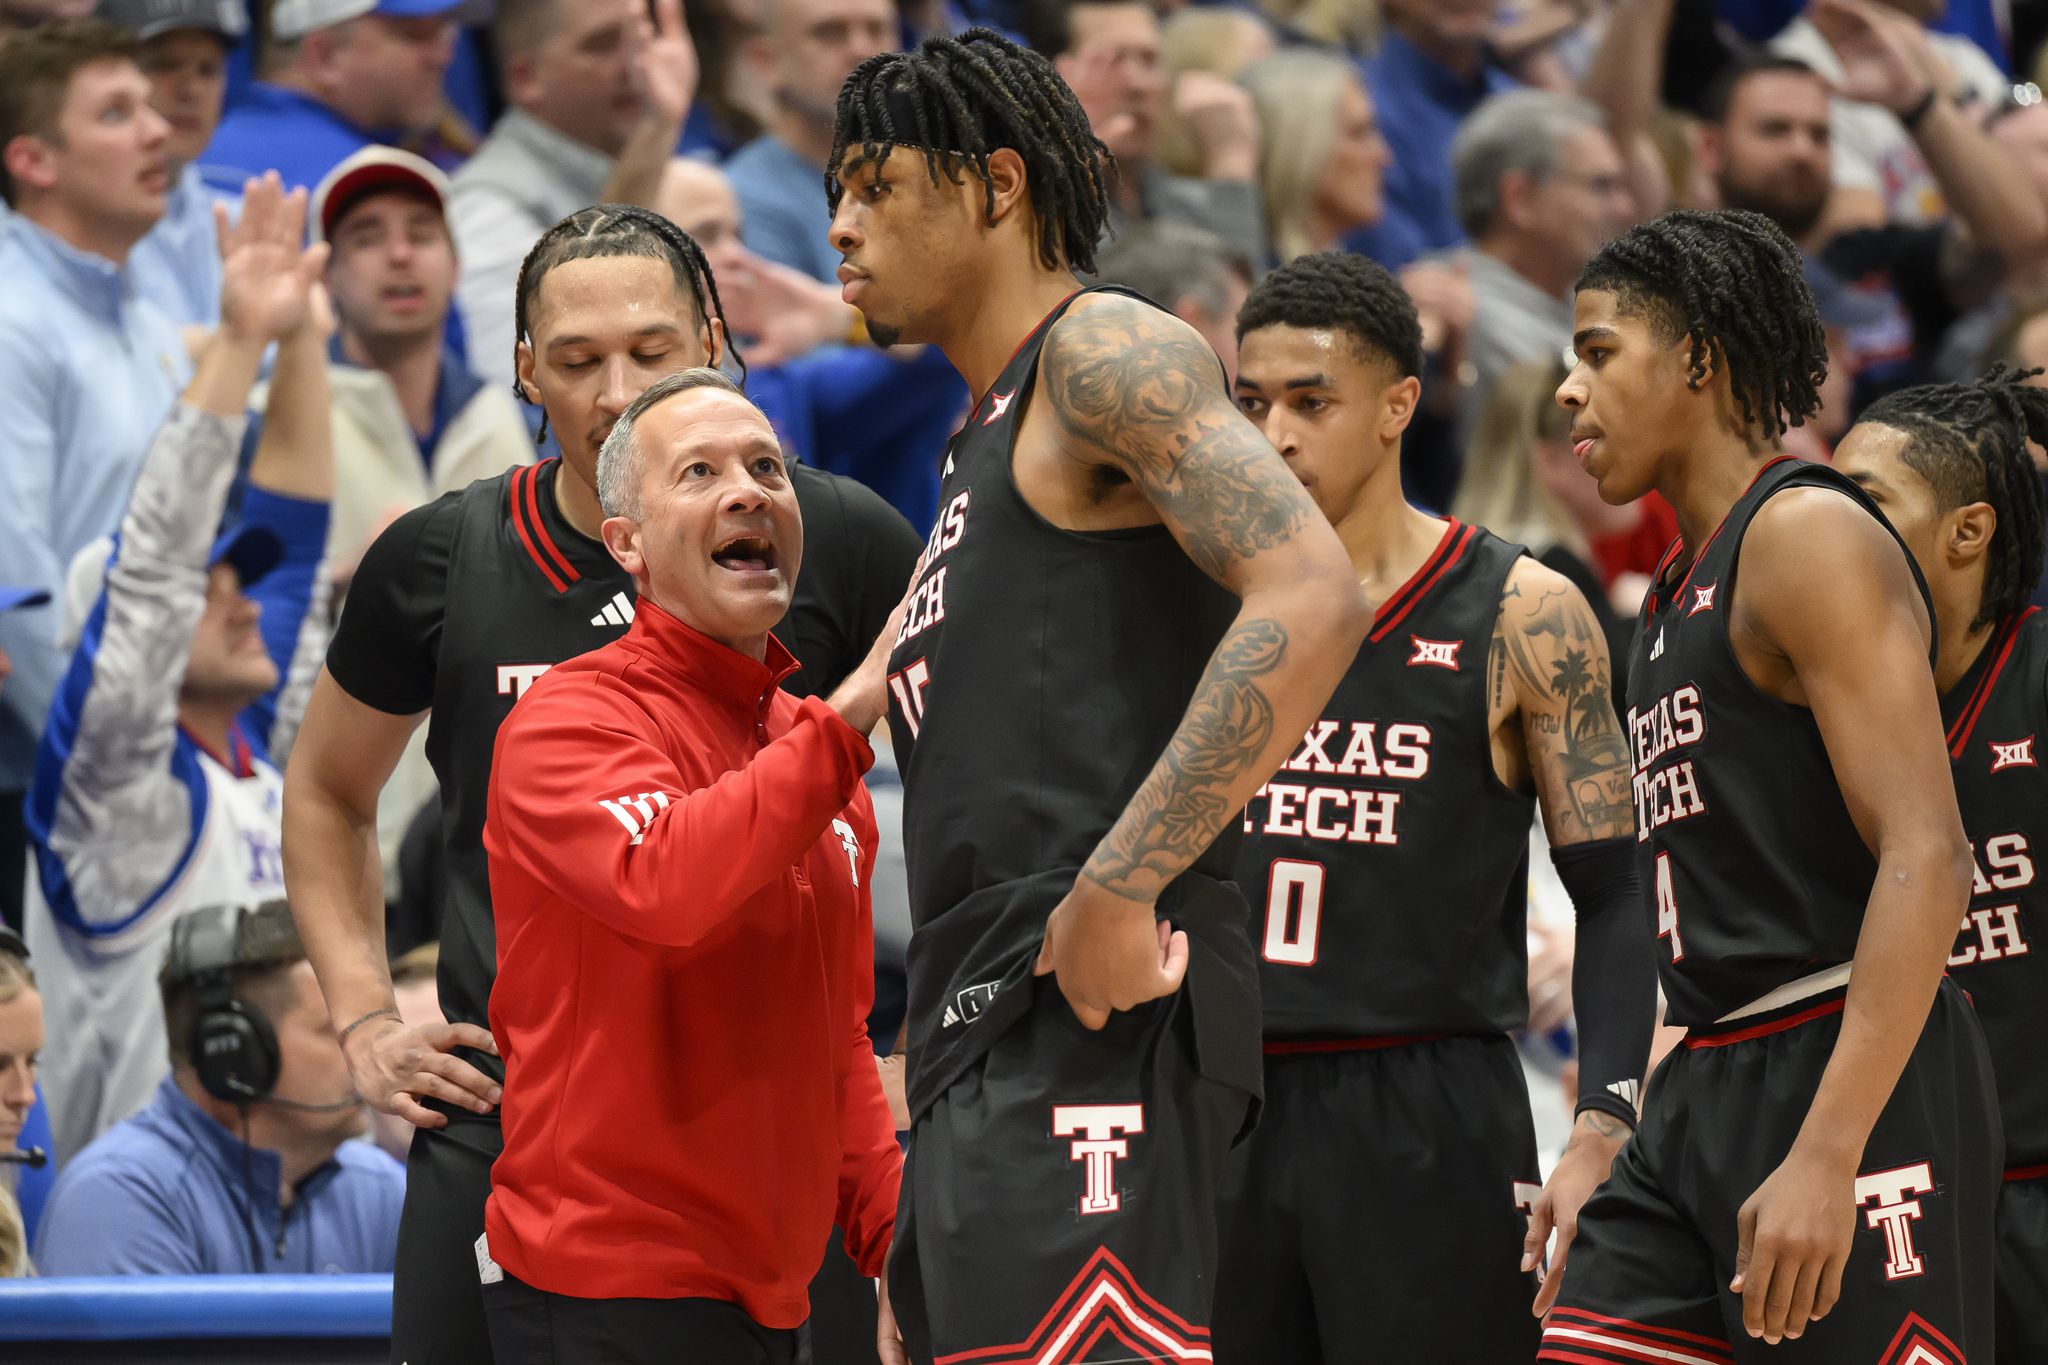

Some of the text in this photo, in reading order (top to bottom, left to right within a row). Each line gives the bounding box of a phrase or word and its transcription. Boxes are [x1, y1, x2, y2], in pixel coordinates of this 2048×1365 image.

[893, 565, 947, 650] ECH
[1409, 635, 1462, 670] XII
[1280, 718, 1433, 780] XAS
[1627, 684, 1704, 780] TEXAS
[1261, 857, 1327, 967] 0
[1655, 851, 1685, 964] 4
